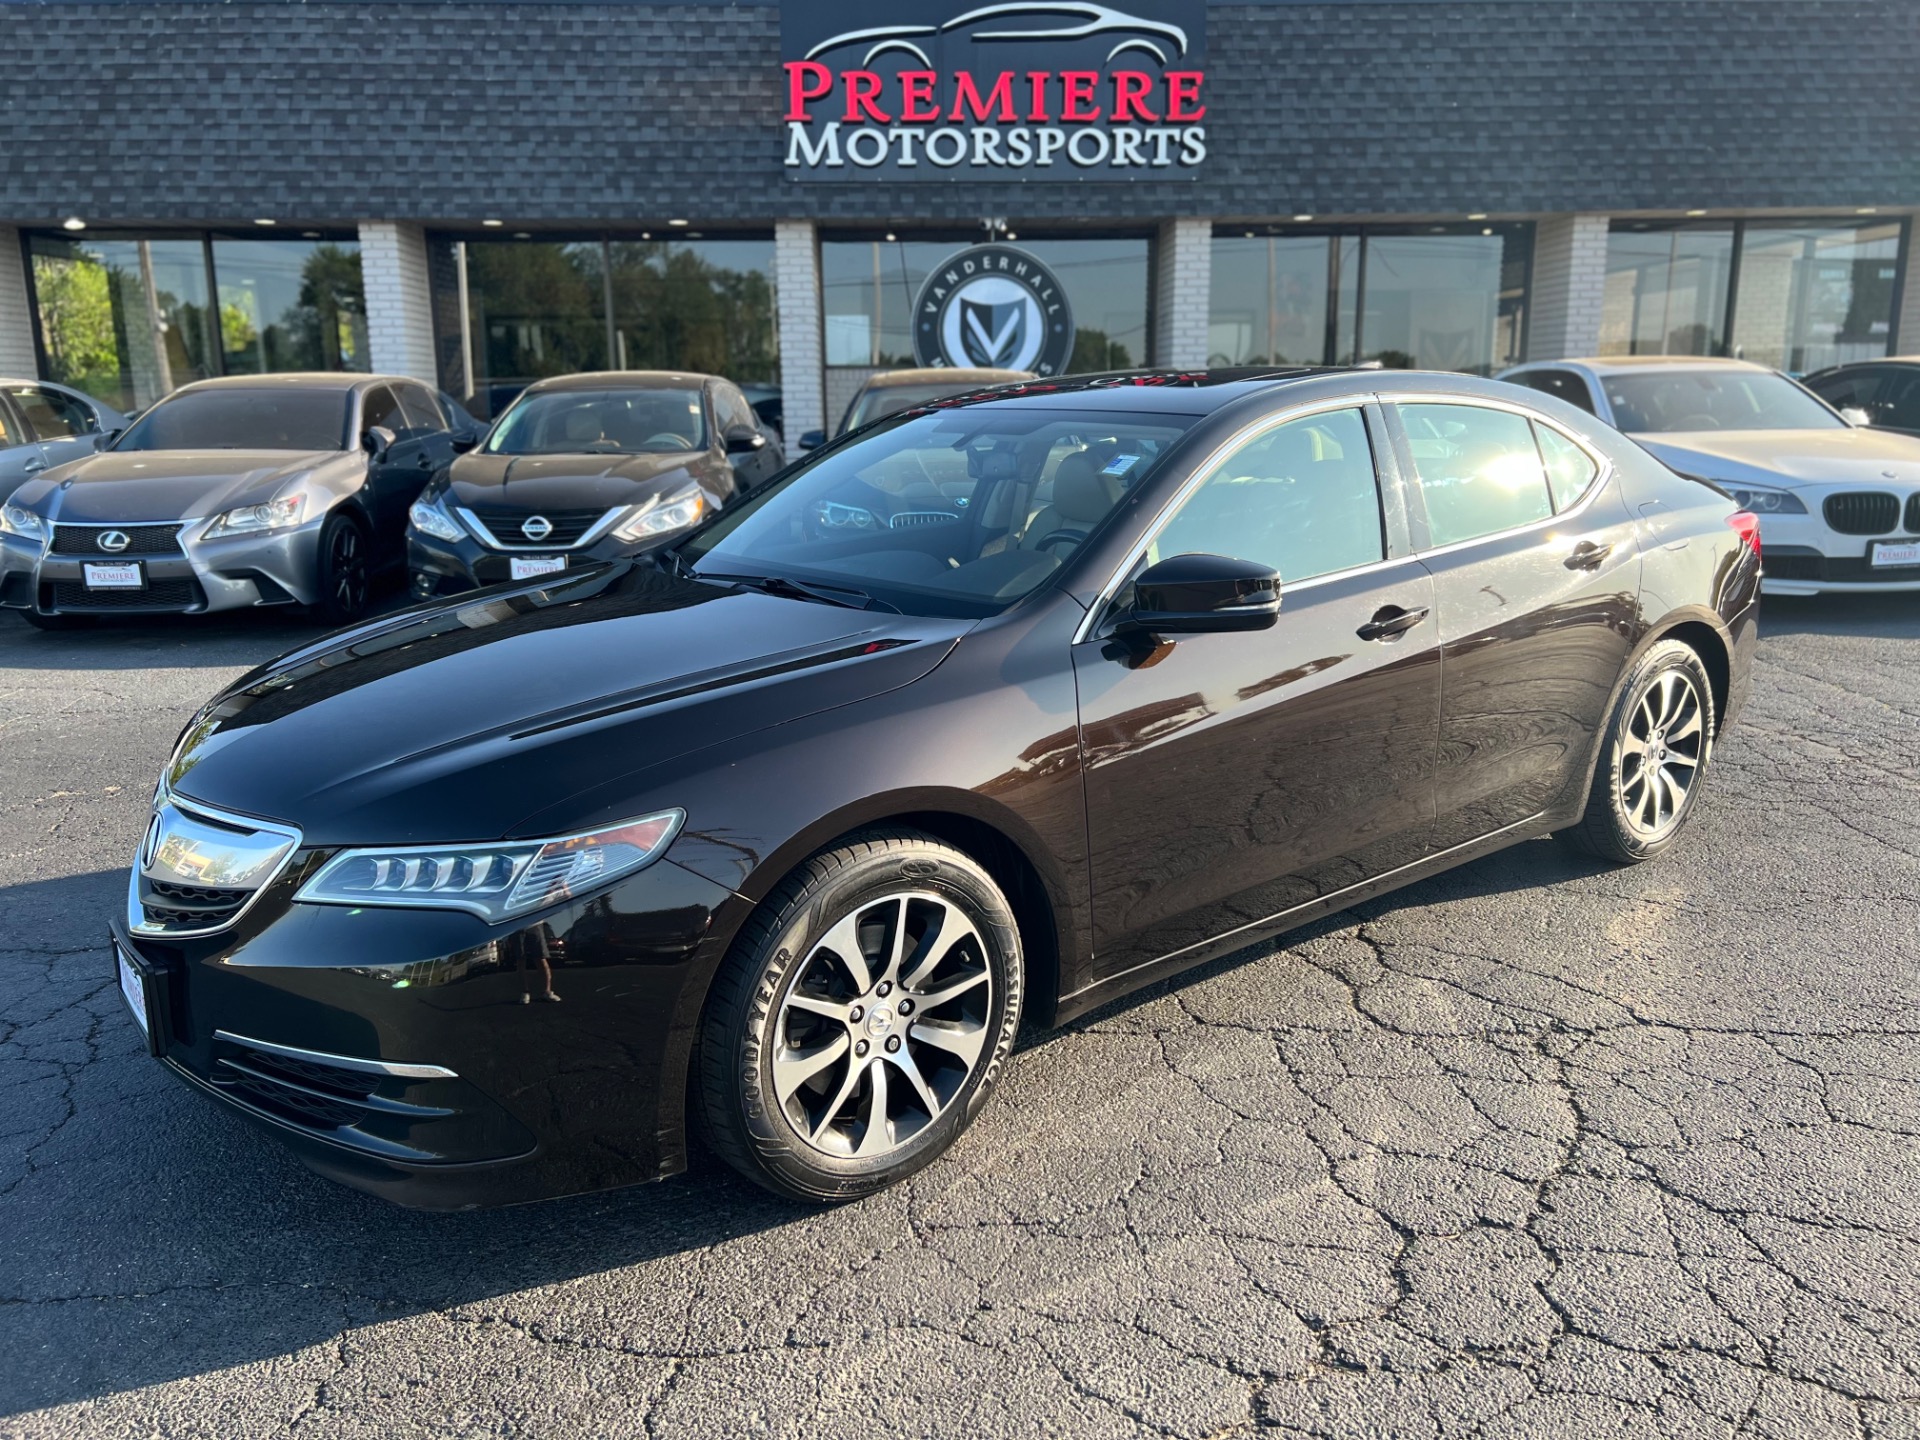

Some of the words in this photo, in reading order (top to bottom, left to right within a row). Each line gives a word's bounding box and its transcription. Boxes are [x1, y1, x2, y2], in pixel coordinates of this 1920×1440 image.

[783, 61, 1206, 122] PREMIERE
[785, 121, 1206, 166] MOTORSPORTS
[924, 255, 1060, 316] VANDERHALL
[91, 571, 136, 580] PREMIERE
[980, 950, 1019, 1092] ASSURANCE
